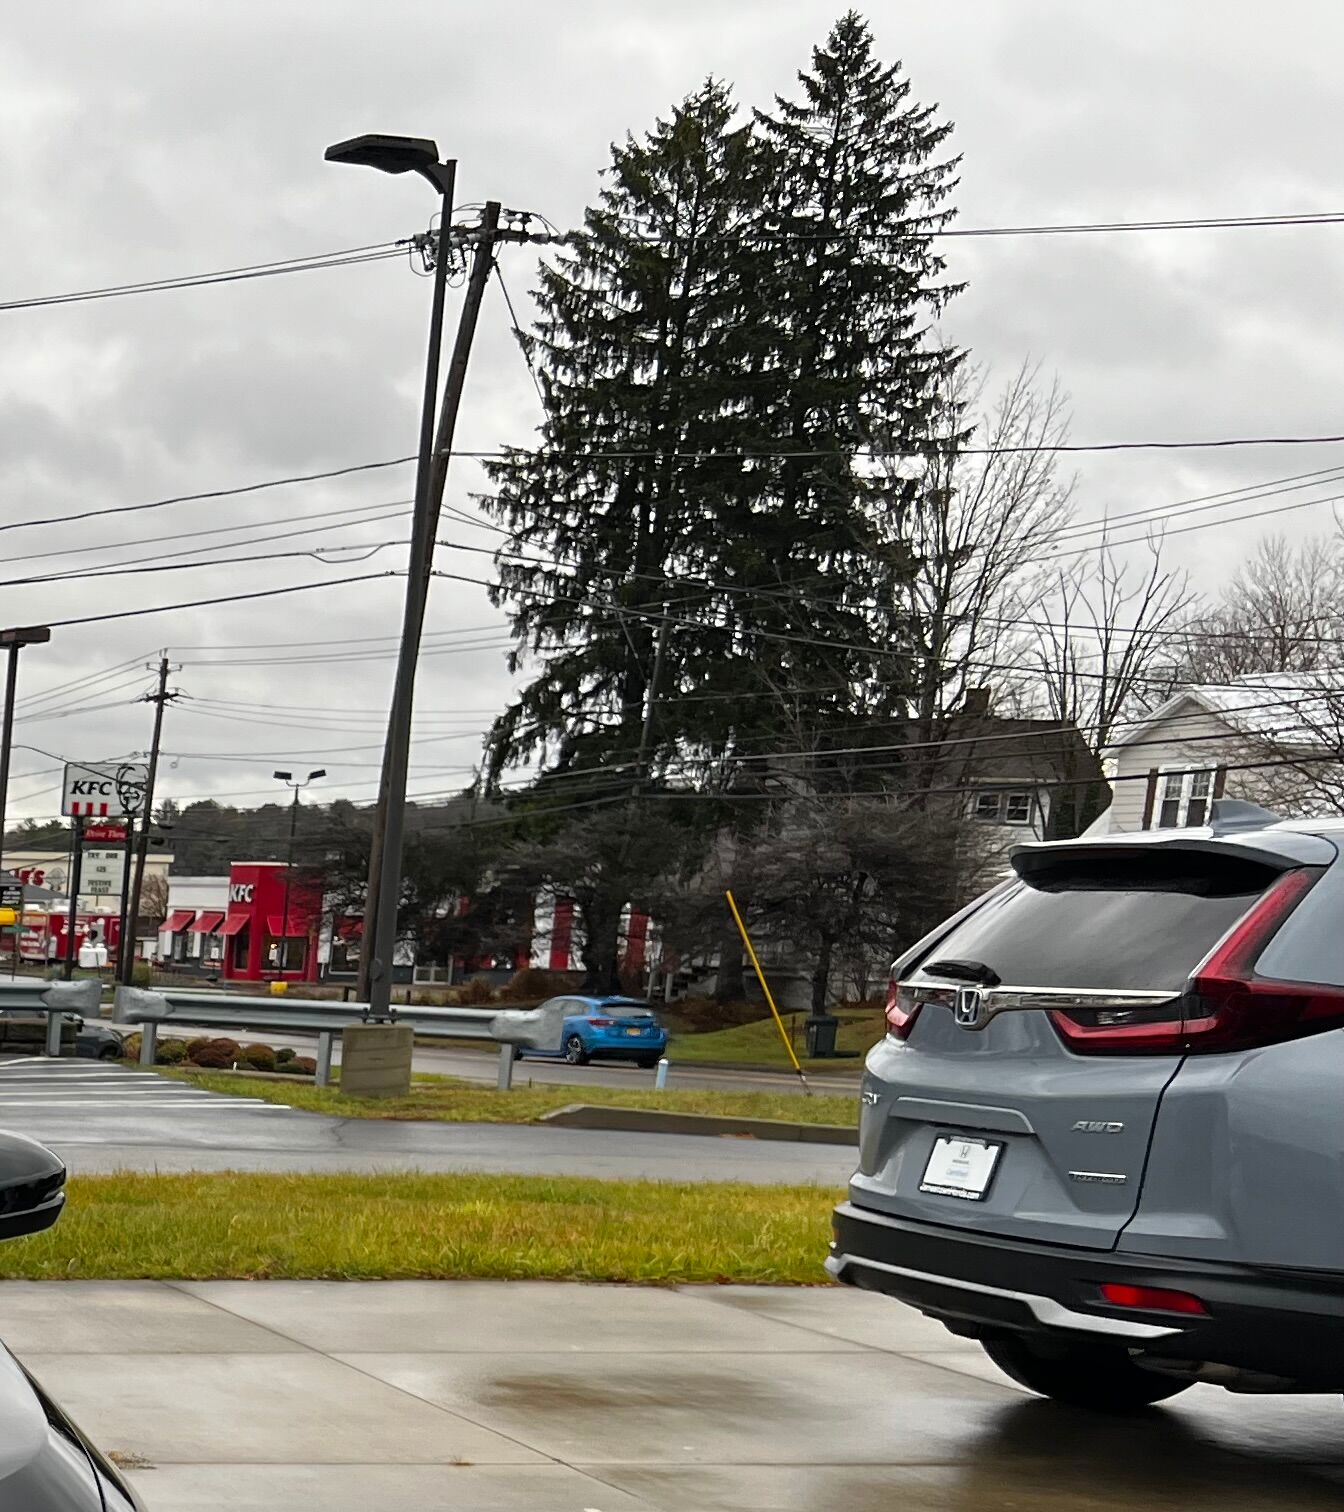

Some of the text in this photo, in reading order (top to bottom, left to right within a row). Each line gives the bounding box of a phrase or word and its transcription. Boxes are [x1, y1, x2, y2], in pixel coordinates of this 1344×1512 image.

[70, 780, 112, 796] KFC
[229, 884, 254, 903] KFC
[1071, 1120, 1124, 1133] AWD
